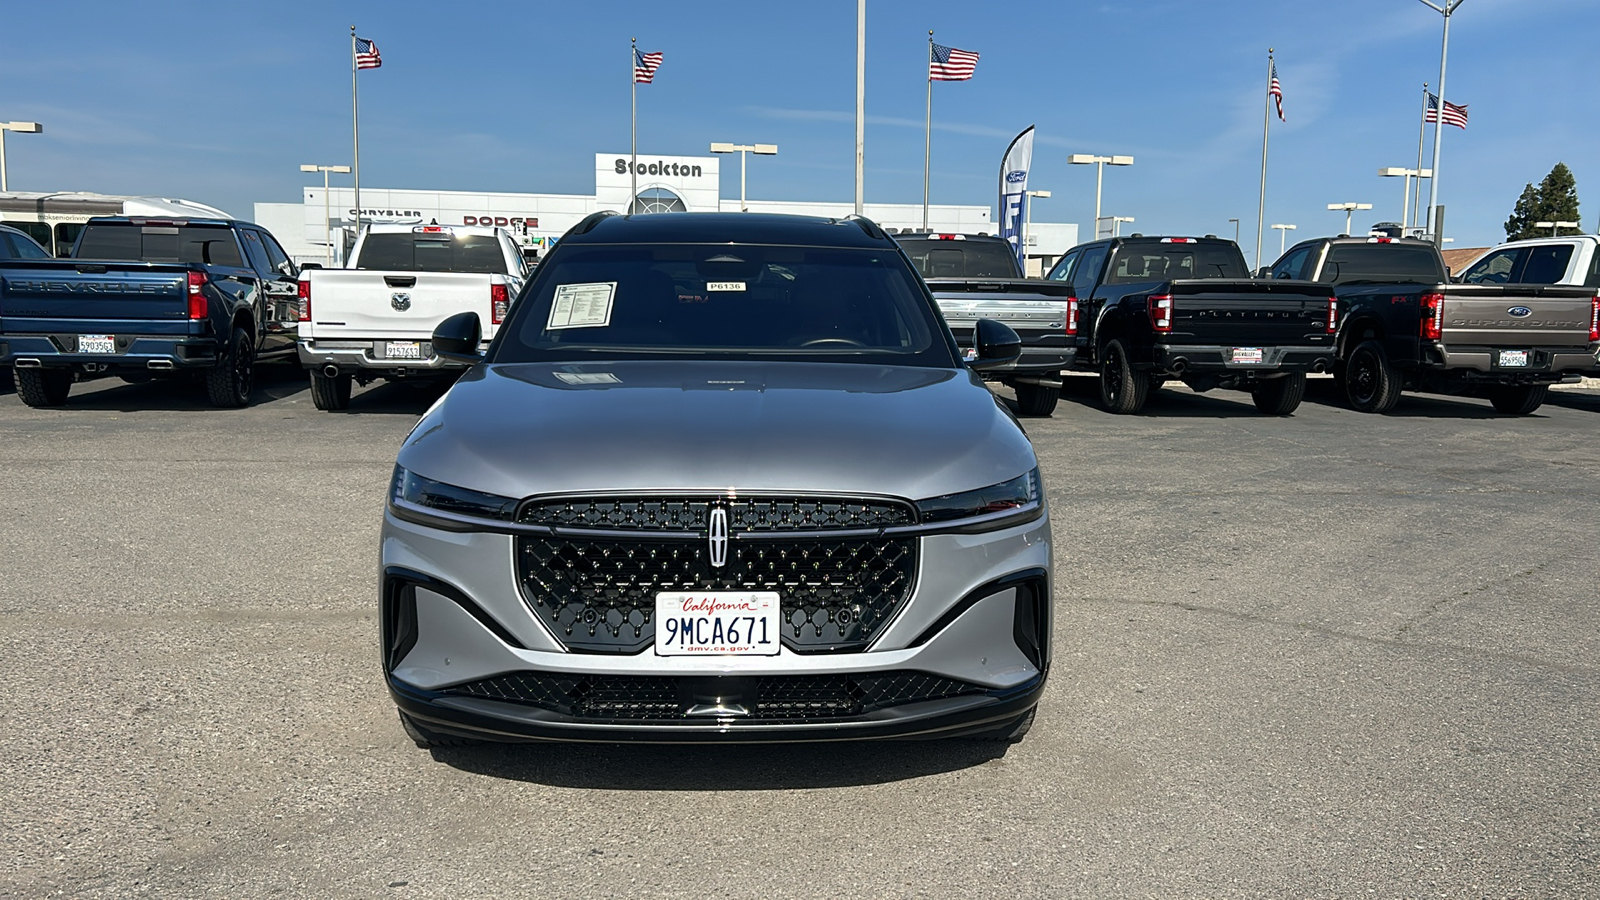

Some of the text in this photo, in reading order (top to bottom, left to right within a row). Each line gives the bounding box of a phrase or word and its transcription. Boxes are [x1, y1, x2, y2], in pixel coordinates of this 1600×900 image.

[615, 158, 702, 177] Stockton
[1008, 172, 1026, 182] Ford
[349, 209, 422, 218] CHRYSLER
[463, 215, 538, 228] DODGE
[9, 281, 173, 294] CHEVROLET
[1452, 319, 1584, 328] SUPER DUTY
[80, 341, 114, 351] 59035G3
[682, 597, 758, 616] California
[665, 616, 771, 646] 9MCA671
